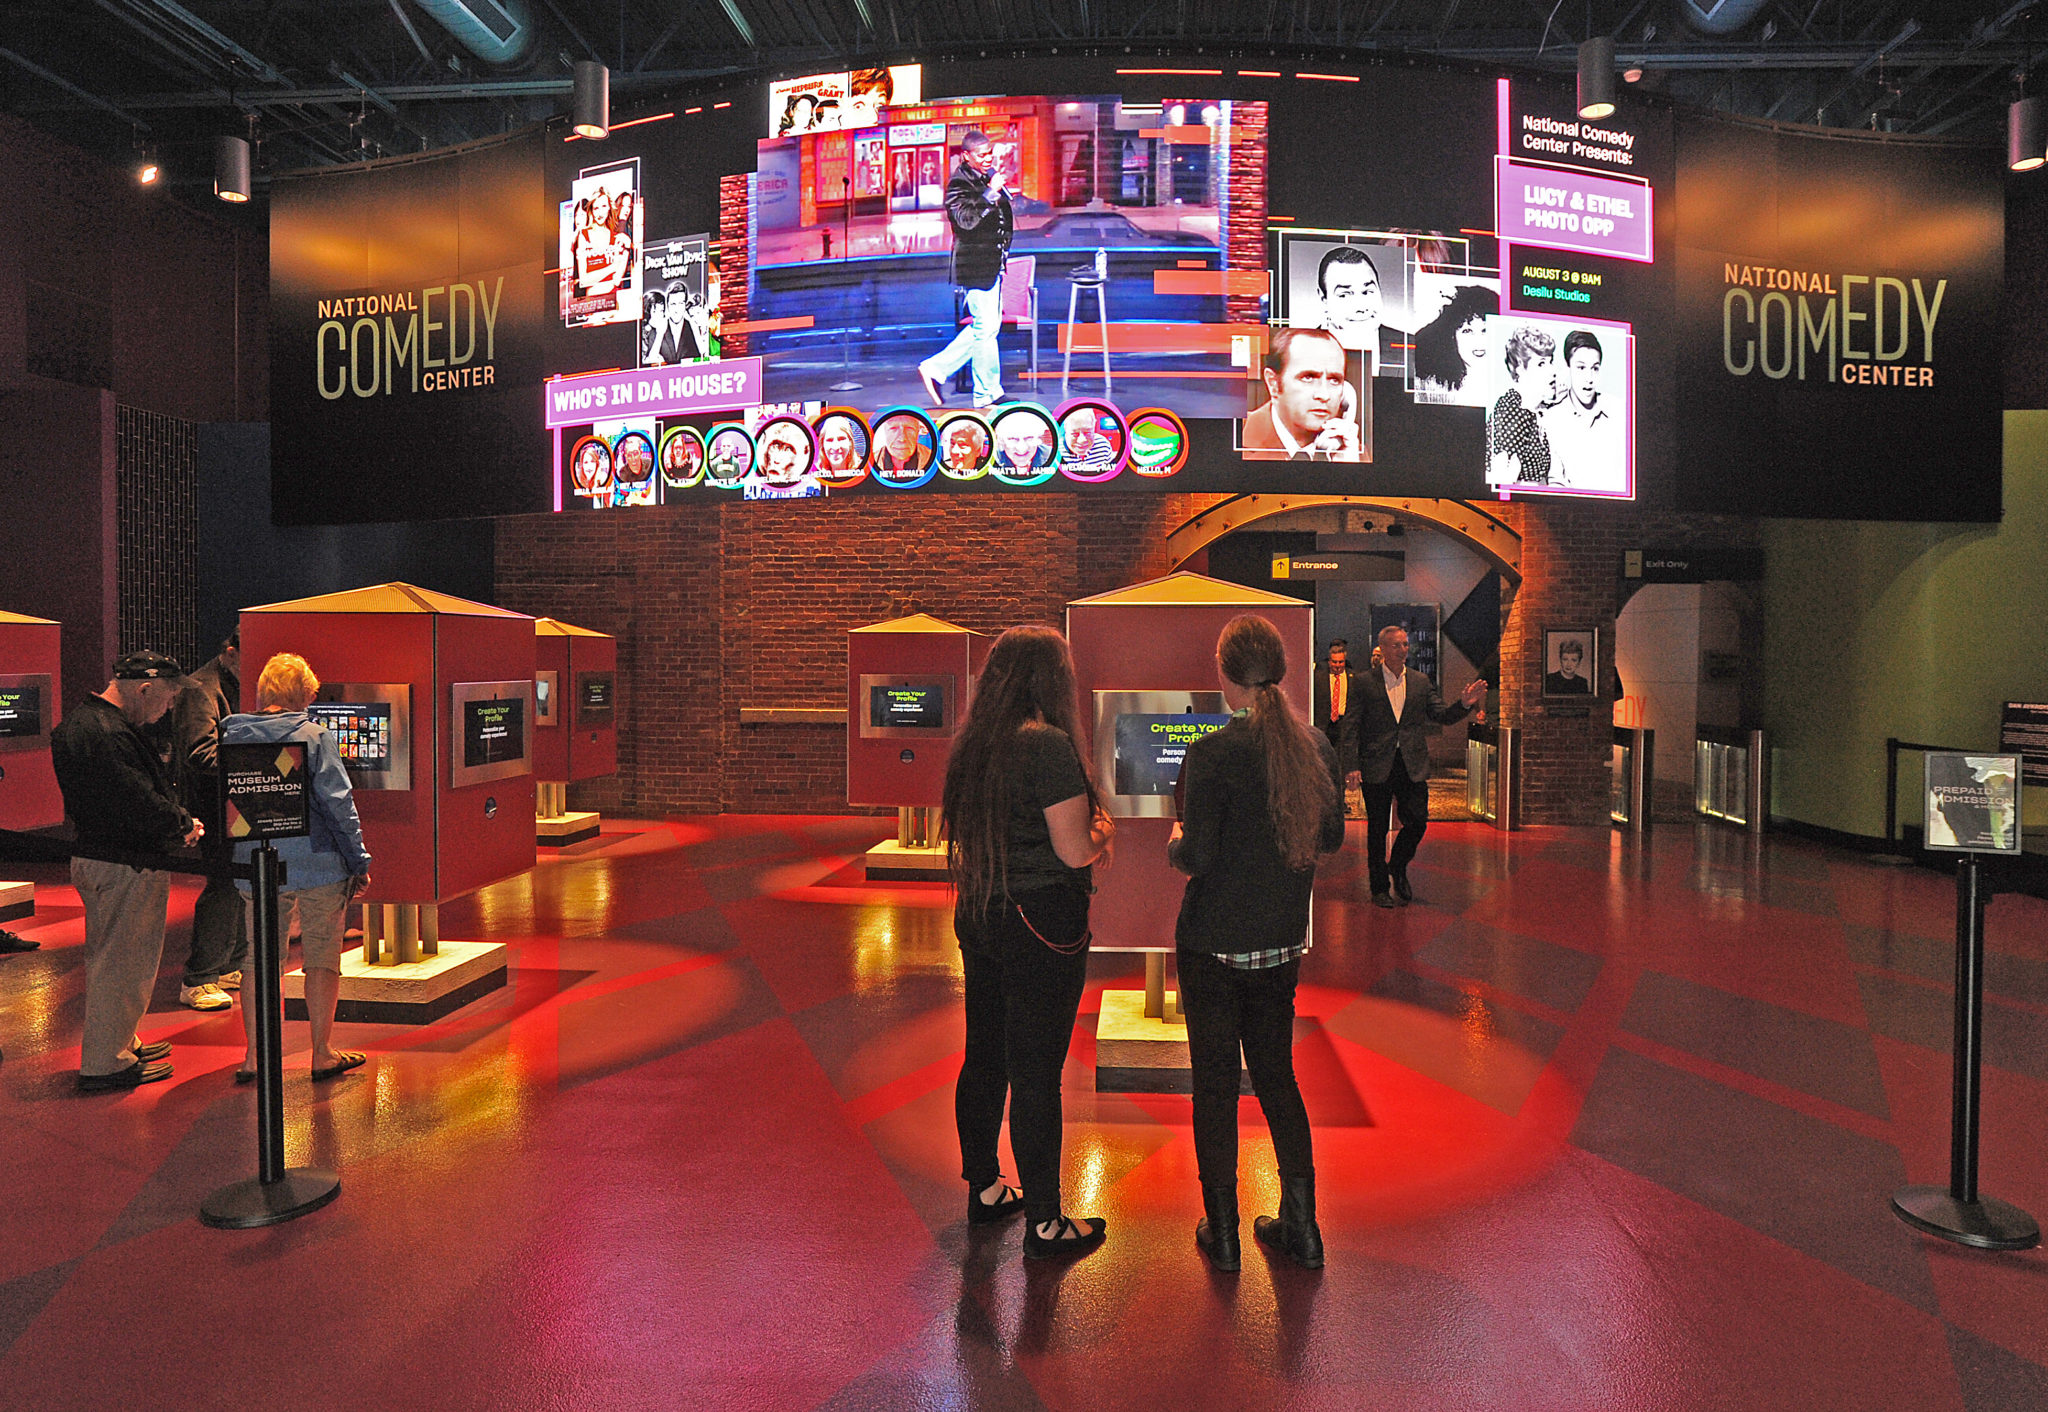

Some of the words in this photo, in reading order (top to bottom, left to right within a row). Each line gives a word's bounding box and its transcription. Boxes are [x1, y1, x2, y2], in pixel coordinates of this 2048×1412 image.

[817, 89, 845, 99] GRANT
[1522, 114, 1579, 138] National
[1581, 124, 1634, 149] Comedy
[1522, 133, 1570, 154] Center
[1572, 141, 1634, 165] Presents:
[1524, 184, 1567, 207] LUCY
[1570, 191, 1585, 211] &
[1586, 193, 1634, 218] ETHEL
[1524, 208, 1579, 232] PHOTO
[1582, 216, 1615, 236] OPP
[661, 265, 689, 280] SHOW
[1522, 265, 1561, 281] AUGUST
[1561, 269, 1570, 282] 3
[1570, 271, 1580, 284] @
[1581, 271, 1602, 286] 9AM
[1724, 262, 1837, 295] NATIONAL
[1522, 284, 1553, 299] Desilu
[1554, 286, 1591, 303] Studios
[317, 291, 418, 319] NATIONAL
[1723, 274, 1948, 383] COMEDY
[317, 276, 504, 400] COMEDY
[423, 365, 495, 392] CENTER
[1841, 363, 1935, 387] CENTER
[554, 384, 607, 412] WHO'S
[611, 383, 633, 405] IN
[637, 379, 664, 402] DA
[668, 371, 747, 399] HOUSE?
[896, 469, 925, 478] DONALD
[1136, 466, 1163, 475] HELLO,
[1292, 561, 1339, 570] Entrance
[1645, 560, 1665, 568] Exit
[1666, 560, 1689, 570] Only
[477, 707, 497, 716] Create
[496, 706, 510, 714] Your
[484, 713, 503, 723] Profile
[1150, 723, 1197, 733] Create
[1162, 748, 1186, 756] Person
[1156, 756, 1183, 765] comedy
[227, 775, 281, 786] MUSEUM
[228, 783, 302, 795] ADMISSION
[1933, 786, 1994, 795] PREPAID
[1937, 794, 2014, 805] DMISSION
